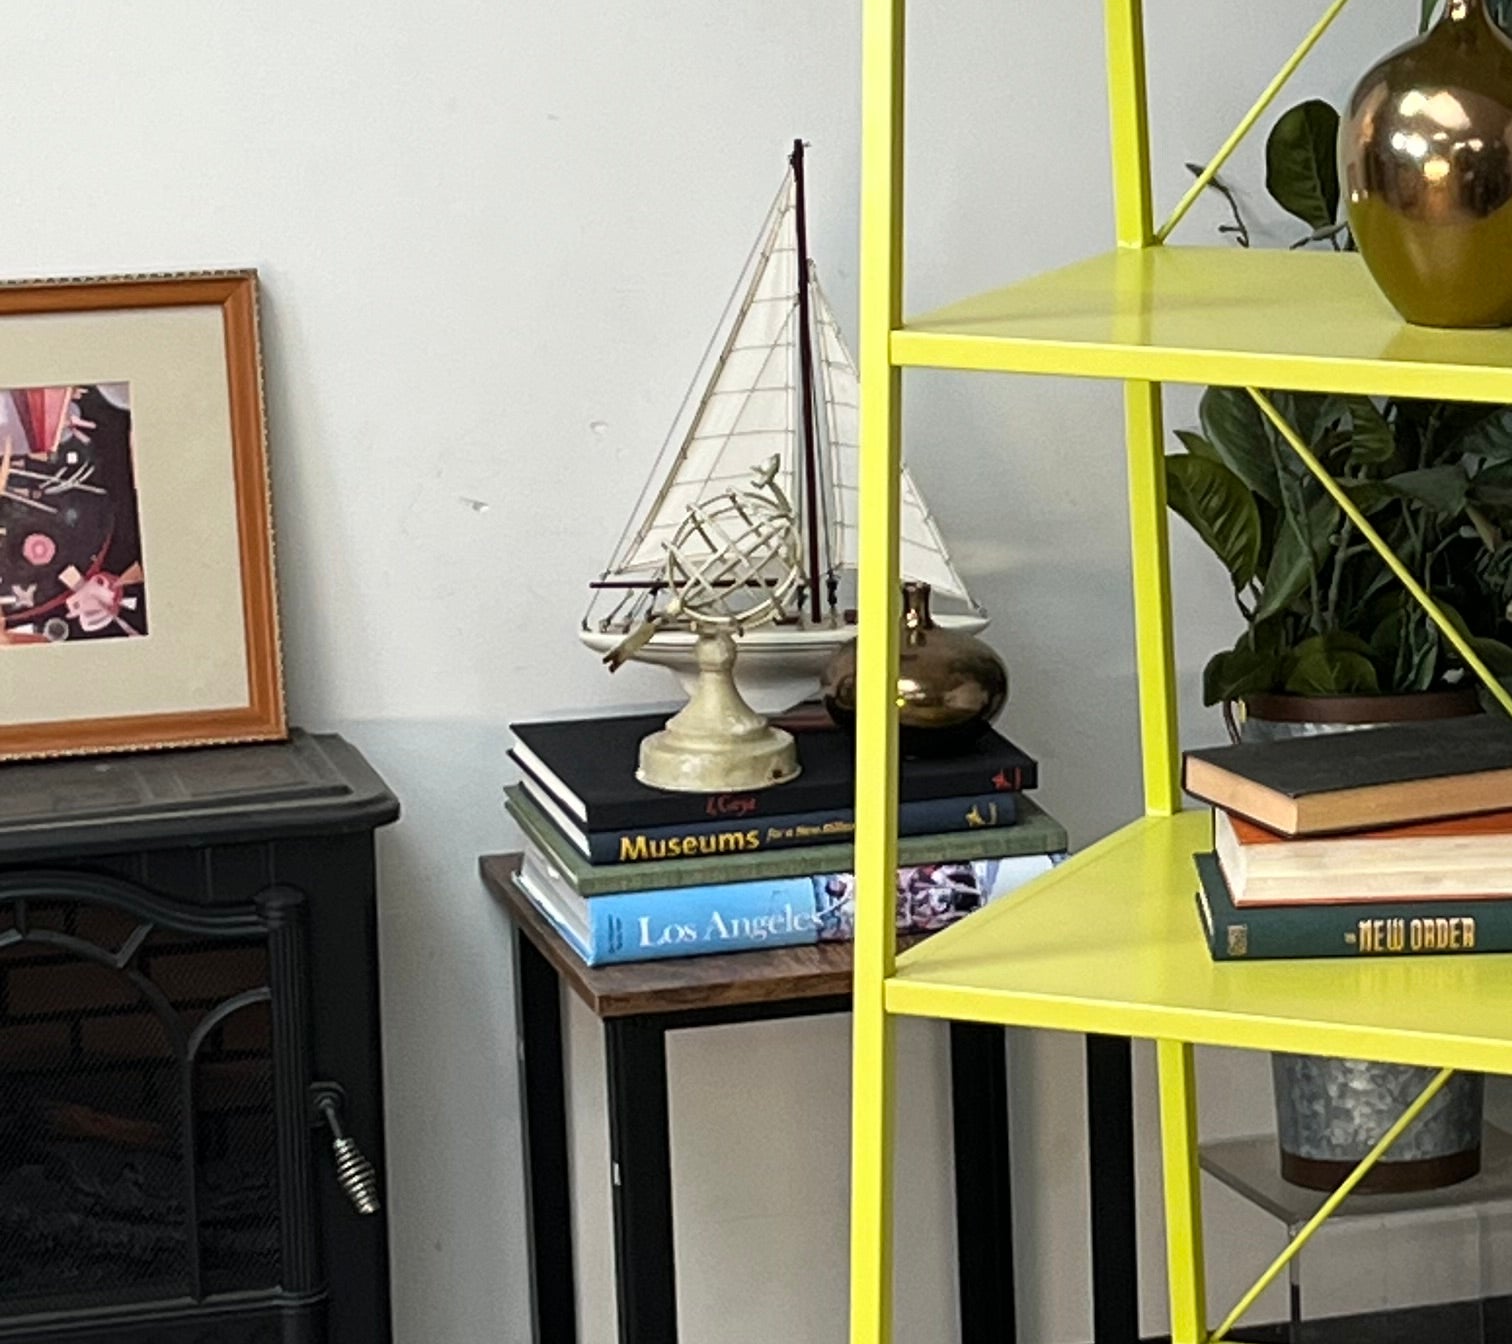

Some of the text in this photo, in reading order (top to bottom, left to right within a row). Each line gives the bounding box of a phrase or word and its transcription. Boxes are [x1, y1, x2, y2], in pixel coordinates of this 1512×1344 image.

[619, 828, 760, 861] Museums
[638, 916, 698, 949] Los
[703, 903, 824, 942] Angeles
[1358, 917, 1475, 952] NEW ORDER
